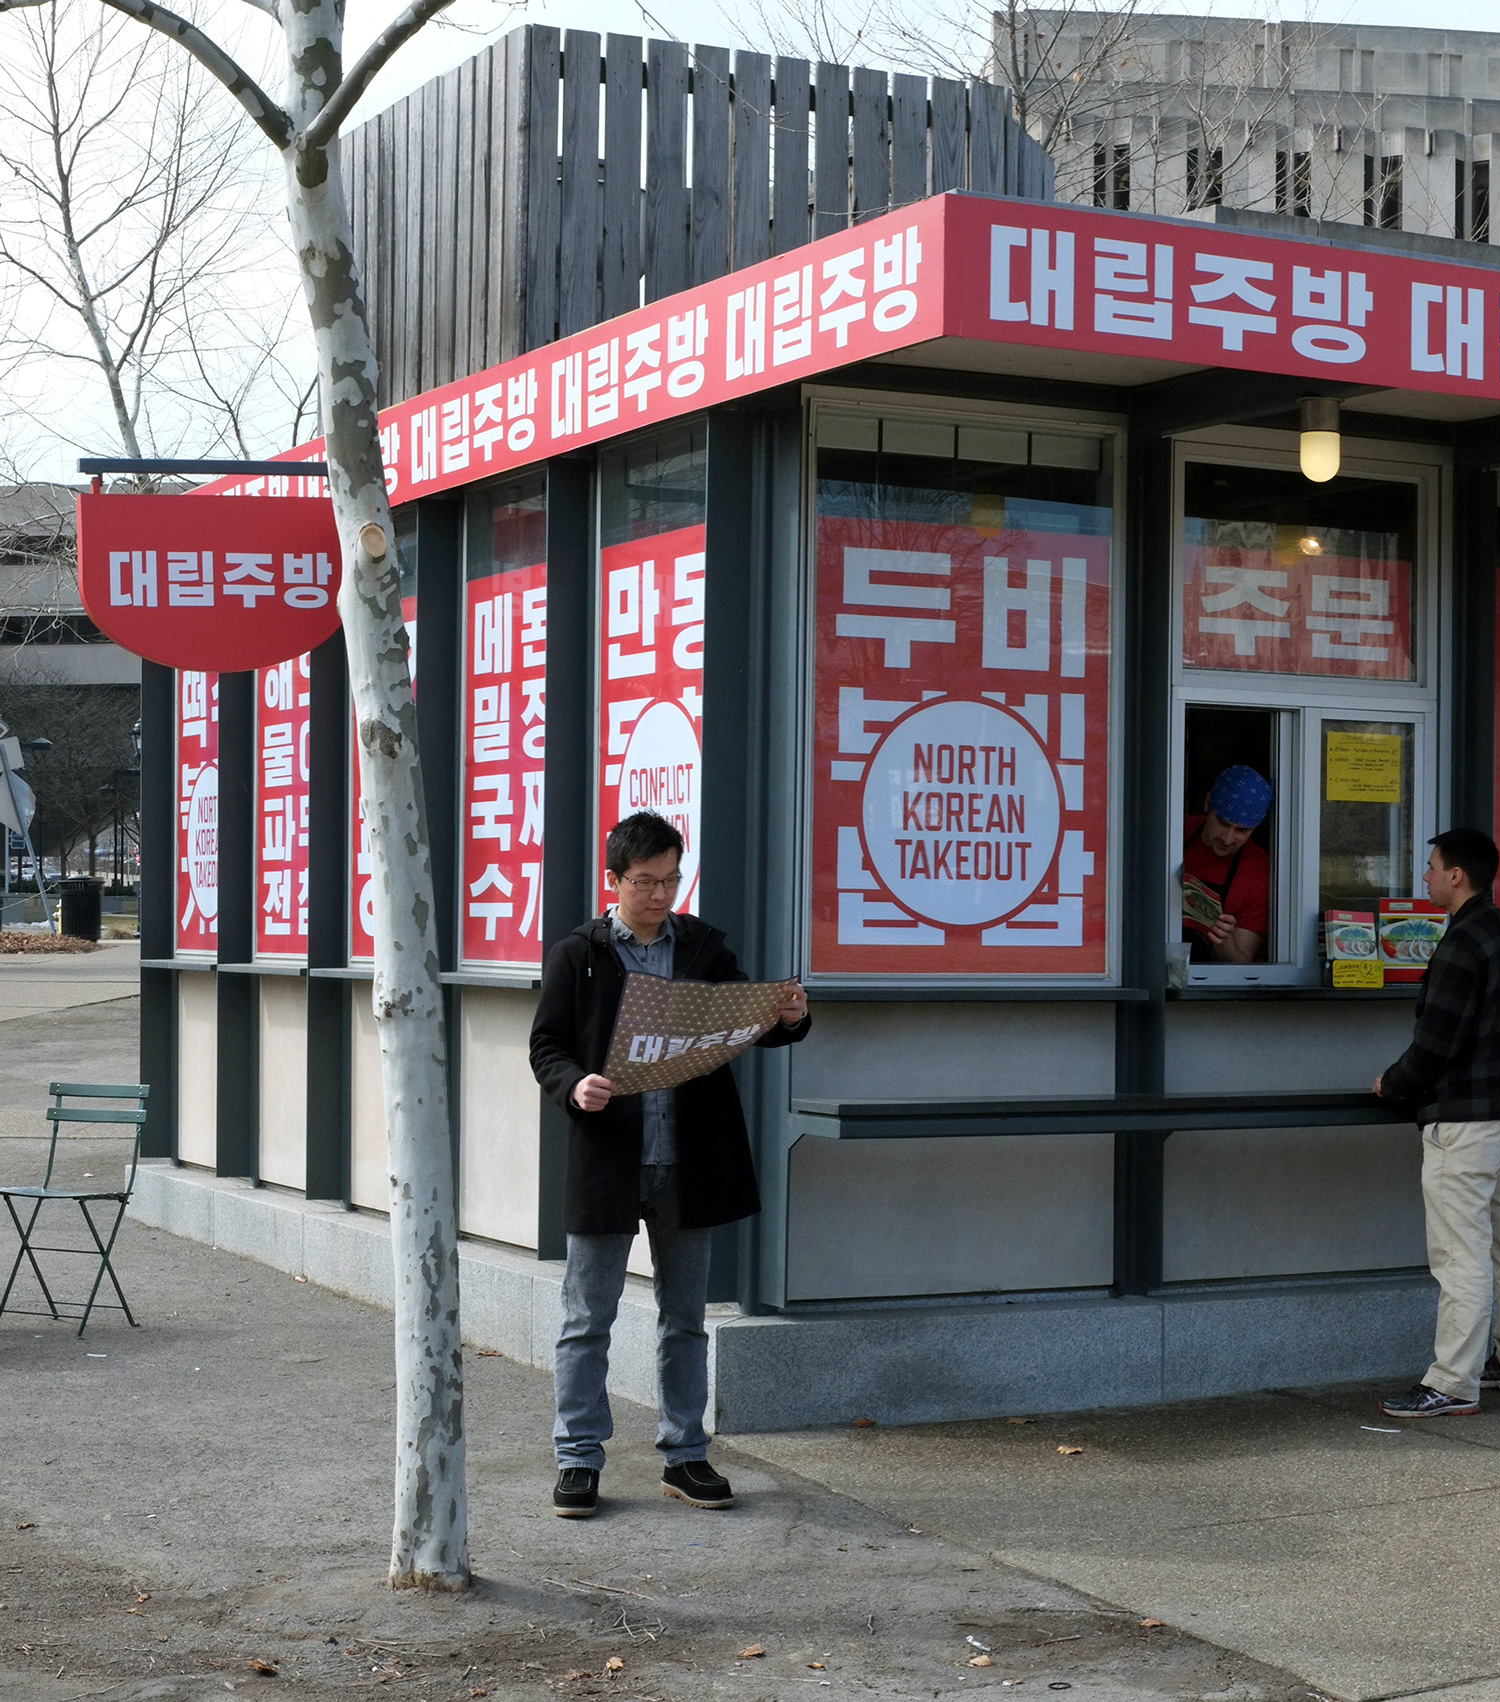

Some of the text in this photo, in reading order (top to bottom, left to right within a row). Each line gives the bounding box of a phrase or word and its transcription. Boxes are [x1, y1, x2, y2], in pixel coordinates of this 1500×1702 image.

[726, 225, 923, 382] 대립주방
[990, 223, 1374, 365] 대립주방
[552, 305, 709, 439] 대립주방
[411, 369, 538, 482] 대립주방
[109, 549, 333, 609] 대립주방
[1199, 565, 1395, 662] 주문
[630, 763, 694, 808] CONFLICT
[913, 743, 1016, 786] NORTH
[198, 796, 218, 823] NORT
[902, 791, 1026, 834] KOREAN
[195, 861, 218, 887] TAKEO
[895, 838, 1032, 882] TAKEOUT
[627, 1023, 761, 1064] 대립주방
